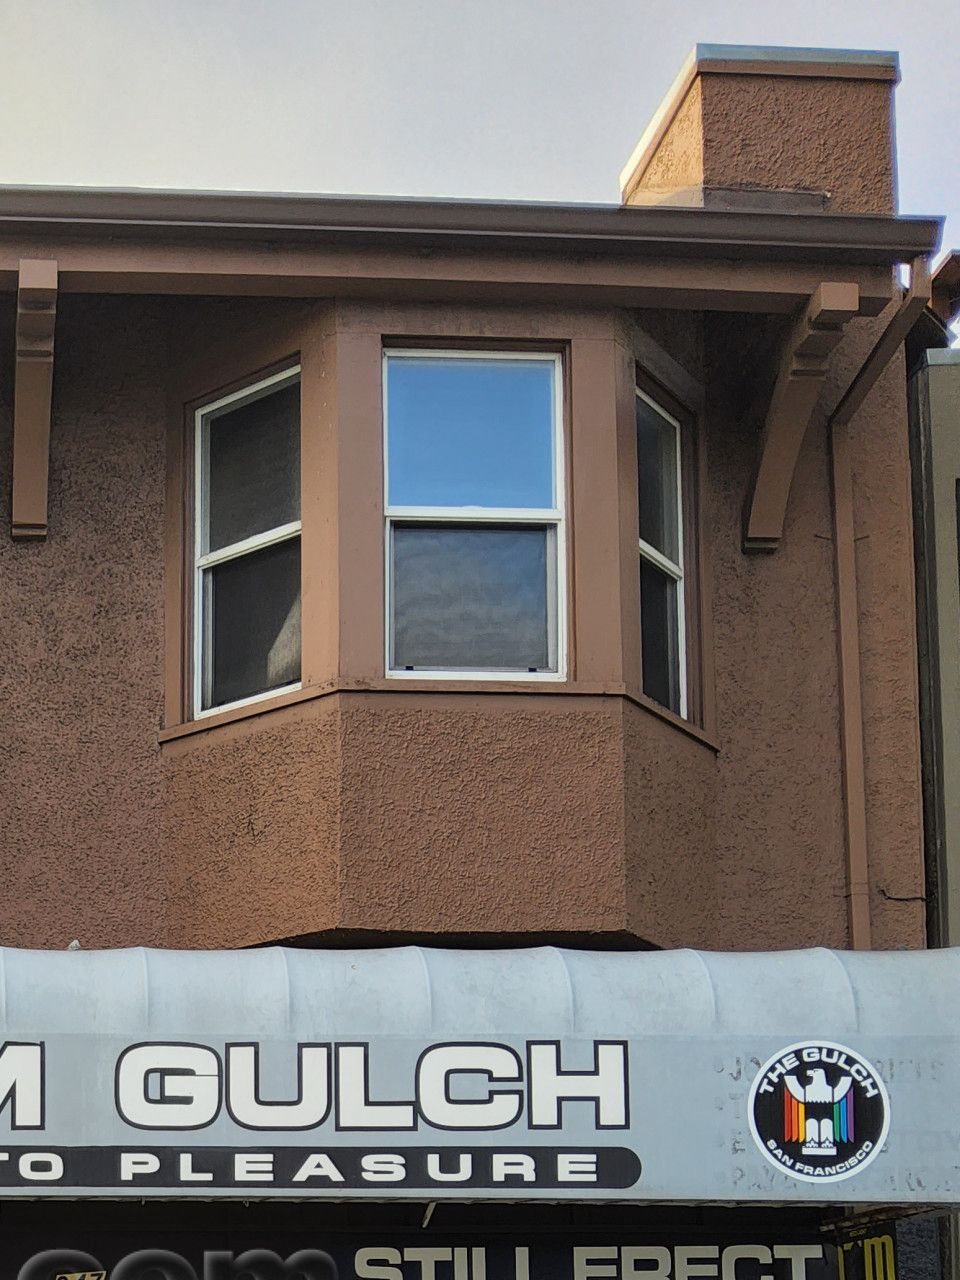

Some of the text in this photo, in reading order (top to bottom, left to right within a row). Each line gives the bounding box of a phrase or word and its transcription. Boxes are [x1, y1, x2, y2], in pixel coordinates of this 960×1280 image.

[114, 1040, 630, 1131] GULCH
[759, 1053, 800, 1095] THE
[802, 1048, 879, 1098] GULCH
[121, 1152, 597, 1182] PLEASURE
[767, 1139, 794, 1166] SAN
[795, 1141, 873, 1176] FRANCISCO
